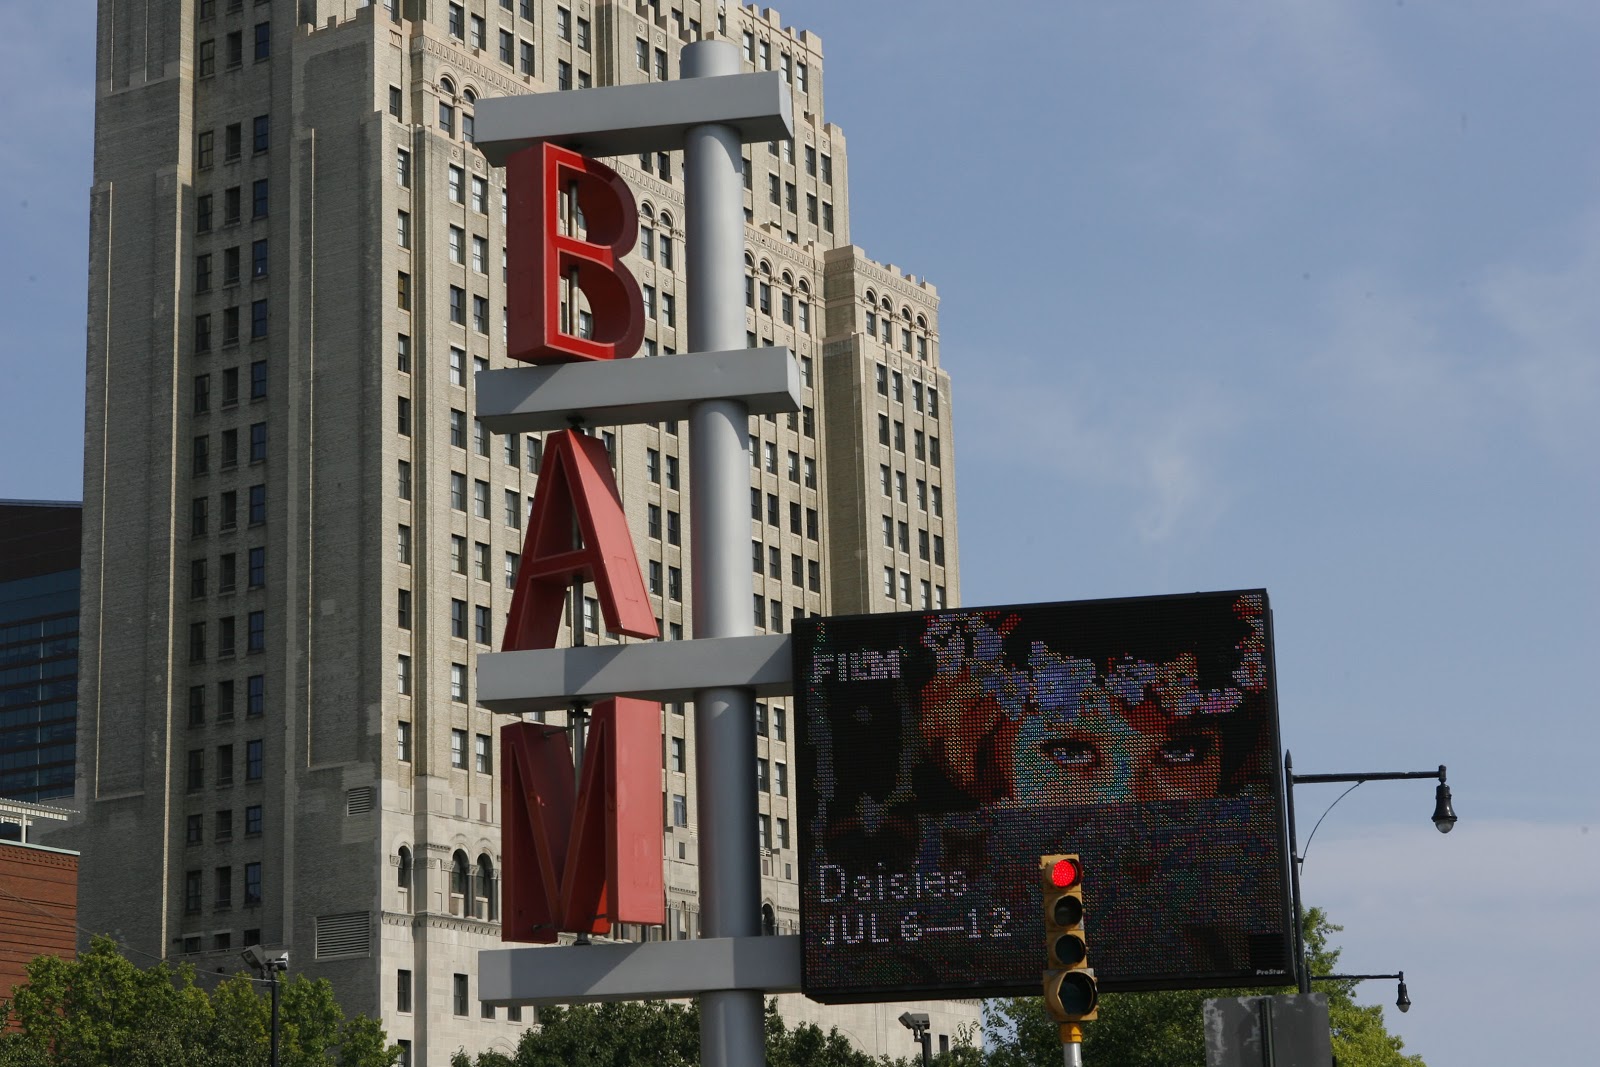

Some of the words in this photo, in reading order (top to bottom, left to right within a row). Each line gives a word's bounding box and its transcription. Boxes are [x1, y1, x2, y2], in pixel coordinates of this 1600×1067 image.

[501, 141, 666, 944] BAM
[810, 649, 901, 684] FILM
[819, 862, 967, 903] Daisies
[821, 912, 890, 945] JUL
